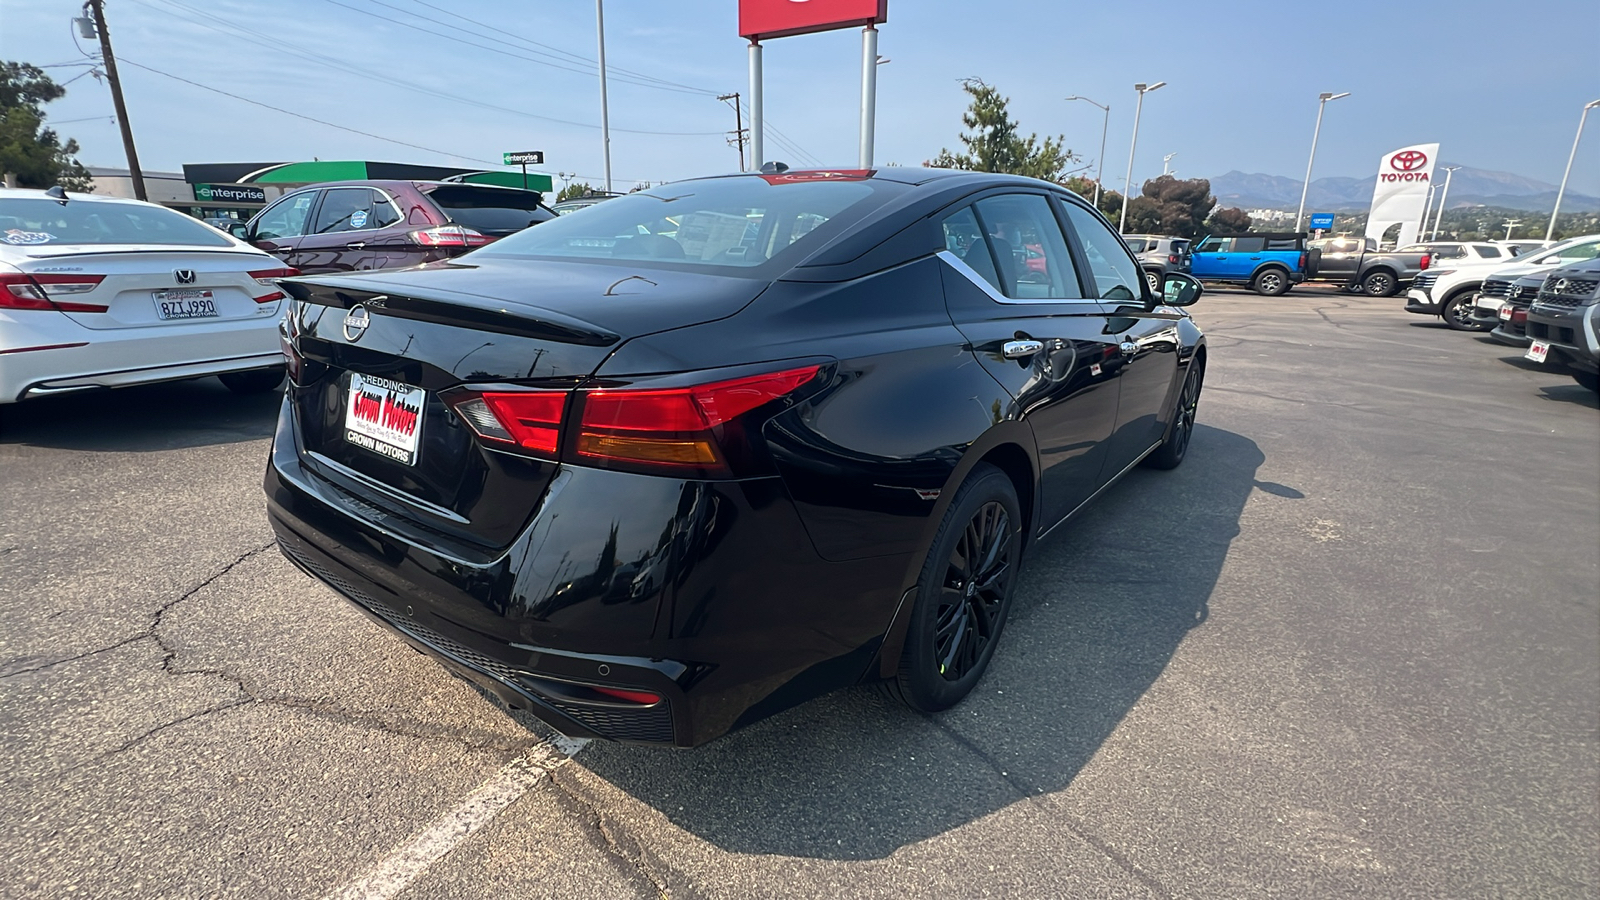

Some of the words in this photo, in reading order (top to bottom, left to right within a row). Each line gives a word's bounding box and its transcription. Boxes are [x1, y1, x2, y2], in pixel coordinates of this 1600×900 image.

[504, 153, 538, 163] enterprise
[1381, 172, 1429, 182] TOYOTA
[196, 188, 264, 200] enterprise
[366, 375, 404, 391] REDDING
[353, 390, 381, 424] Crown
[382, 391, 418, 437] Motors
[347, 431, 375, 450] CROWN
[375, 440, 409, 462] MOTORS
